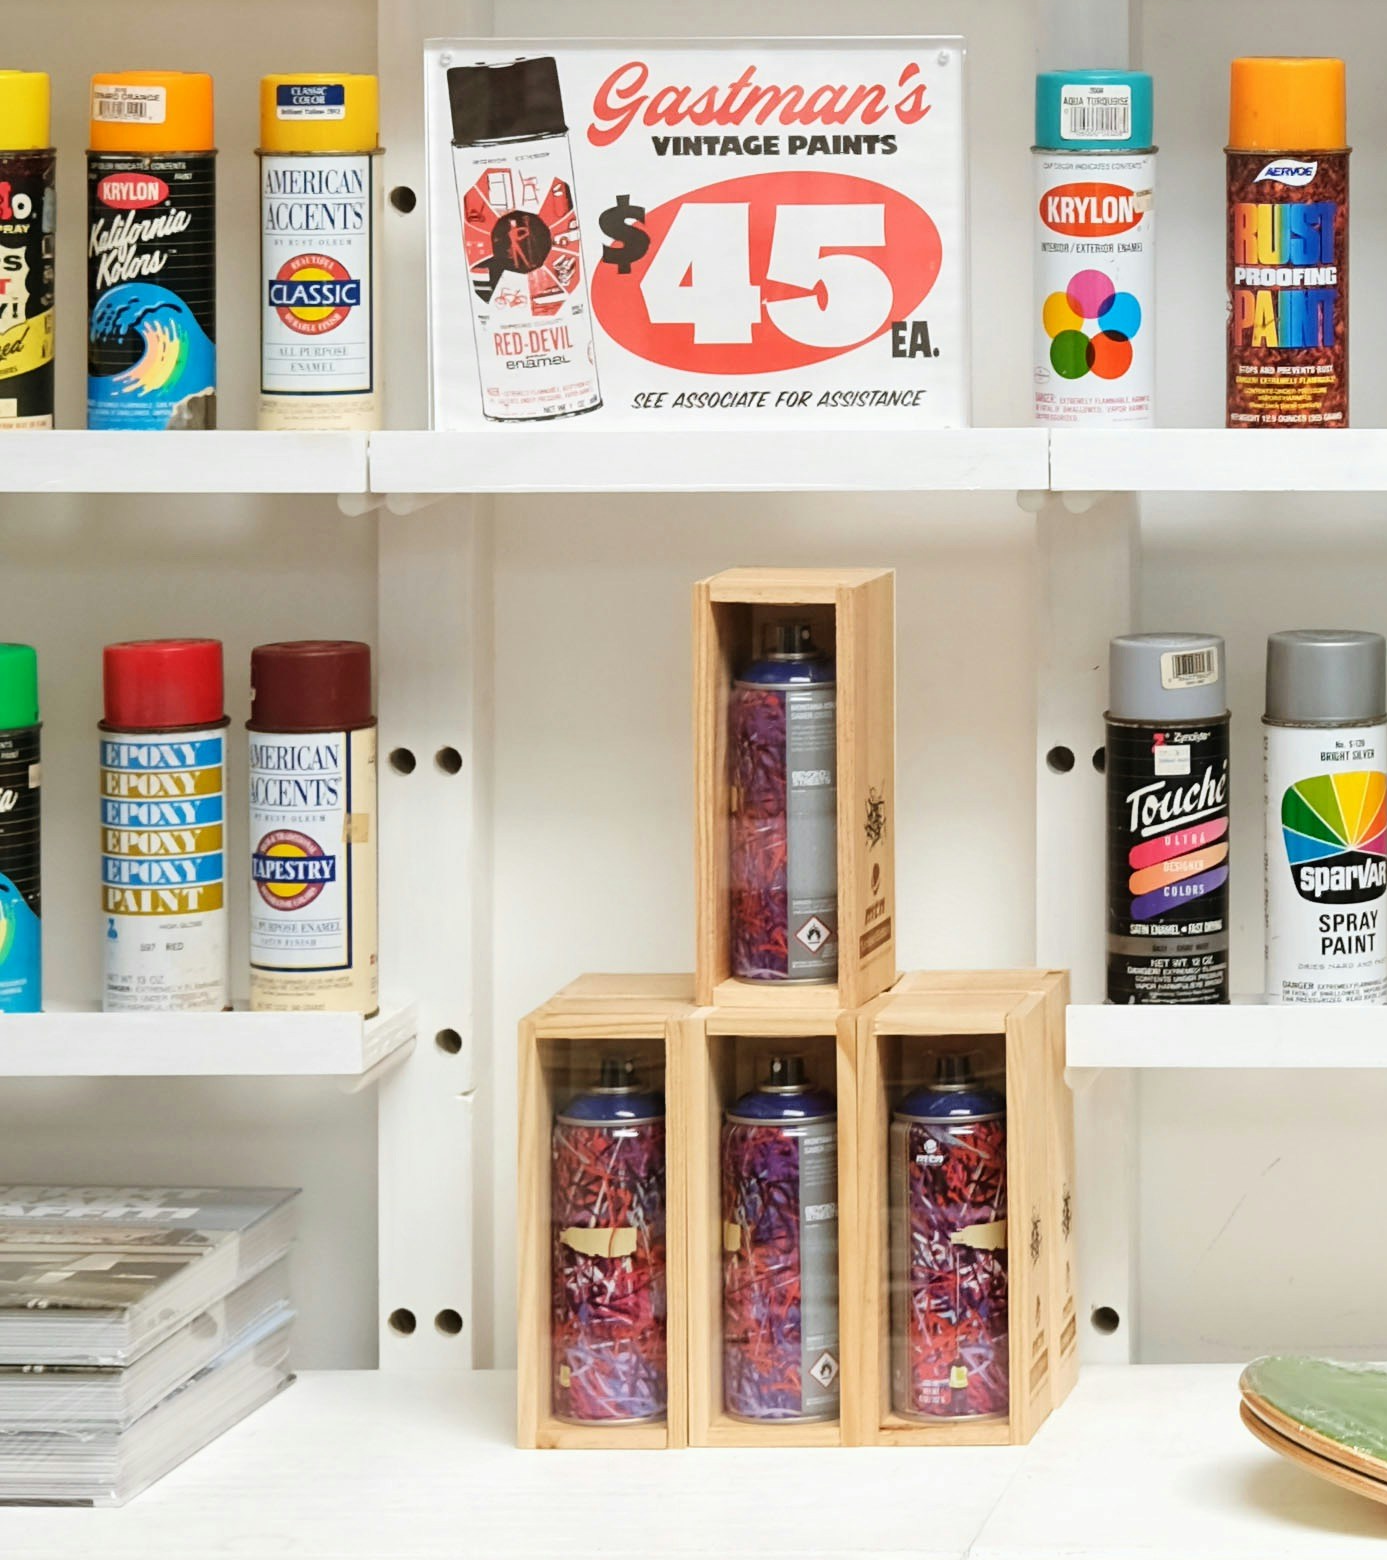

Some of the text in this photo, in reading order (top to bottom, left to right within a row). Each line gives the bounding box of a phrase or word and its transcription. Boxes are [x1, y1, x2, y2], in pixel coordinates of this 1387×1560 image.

[587, 60, 932, 147] Gastman's
[652, 134, 898, 156] VINTAGE PAINTS
[89, 207, 191, 262] Kalifornia
[96, 249, 166, 289] Kolors
[599, 194, 893, 347] $45
[1234, 266, 1337, 285] PROOFING
[494, 325, 573, 357] RED-DEVIL
[891, 321, 940, 358] EA.
[632, 390, 926, 408] SEE ASSOCIATE FOR ASSISTANCE
[104, 743, 199, 766] EPOXY
[1320, 749, 1375, 760] BRIGHT SILVER
